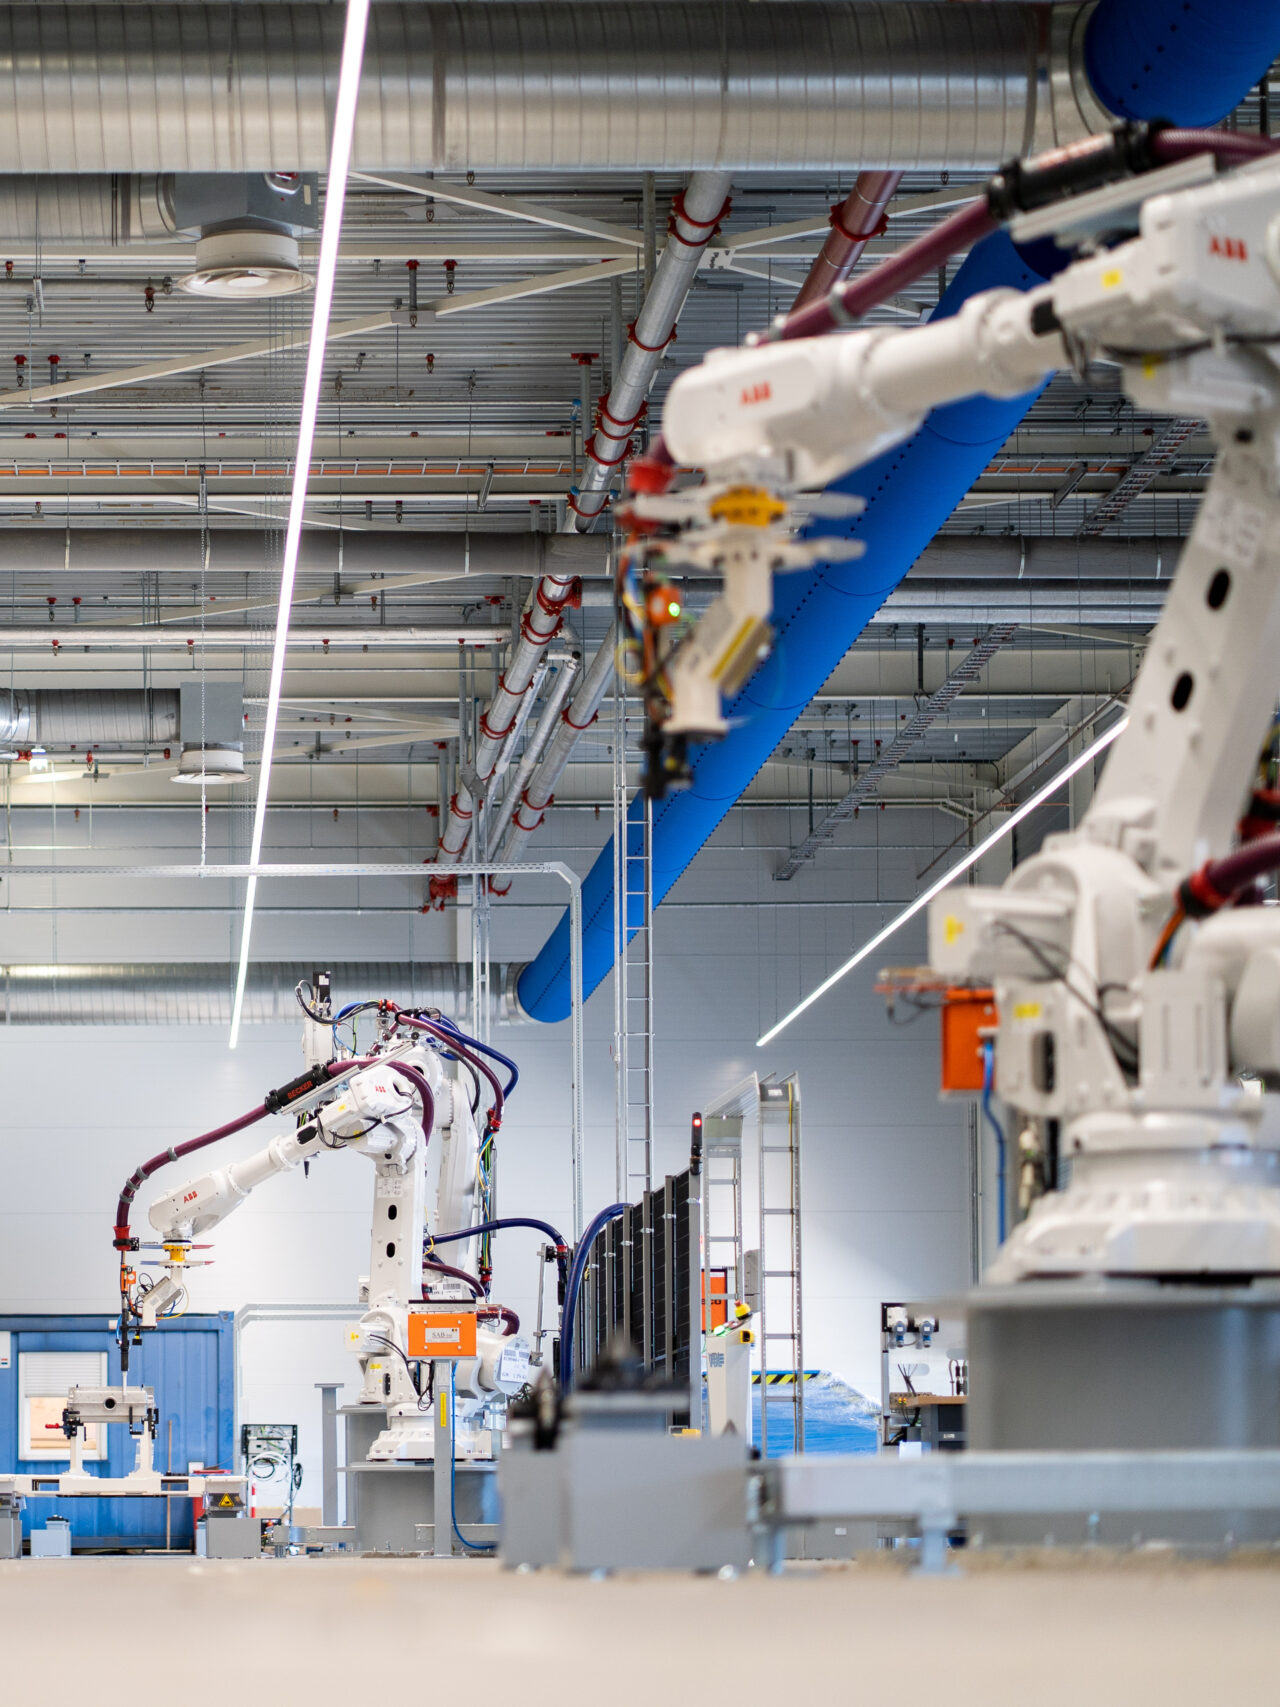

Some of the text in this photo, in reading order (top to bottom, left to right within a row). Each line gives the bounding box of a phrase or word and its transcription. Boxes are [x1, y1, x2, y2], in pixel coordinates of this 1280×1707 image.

[1208, 235, 1248, 263] ABB
[740, 382, 772, 405] ABB
[287, 1080, 314, 1099] BECKER
[183, 1190, 198, 1203] ABB
